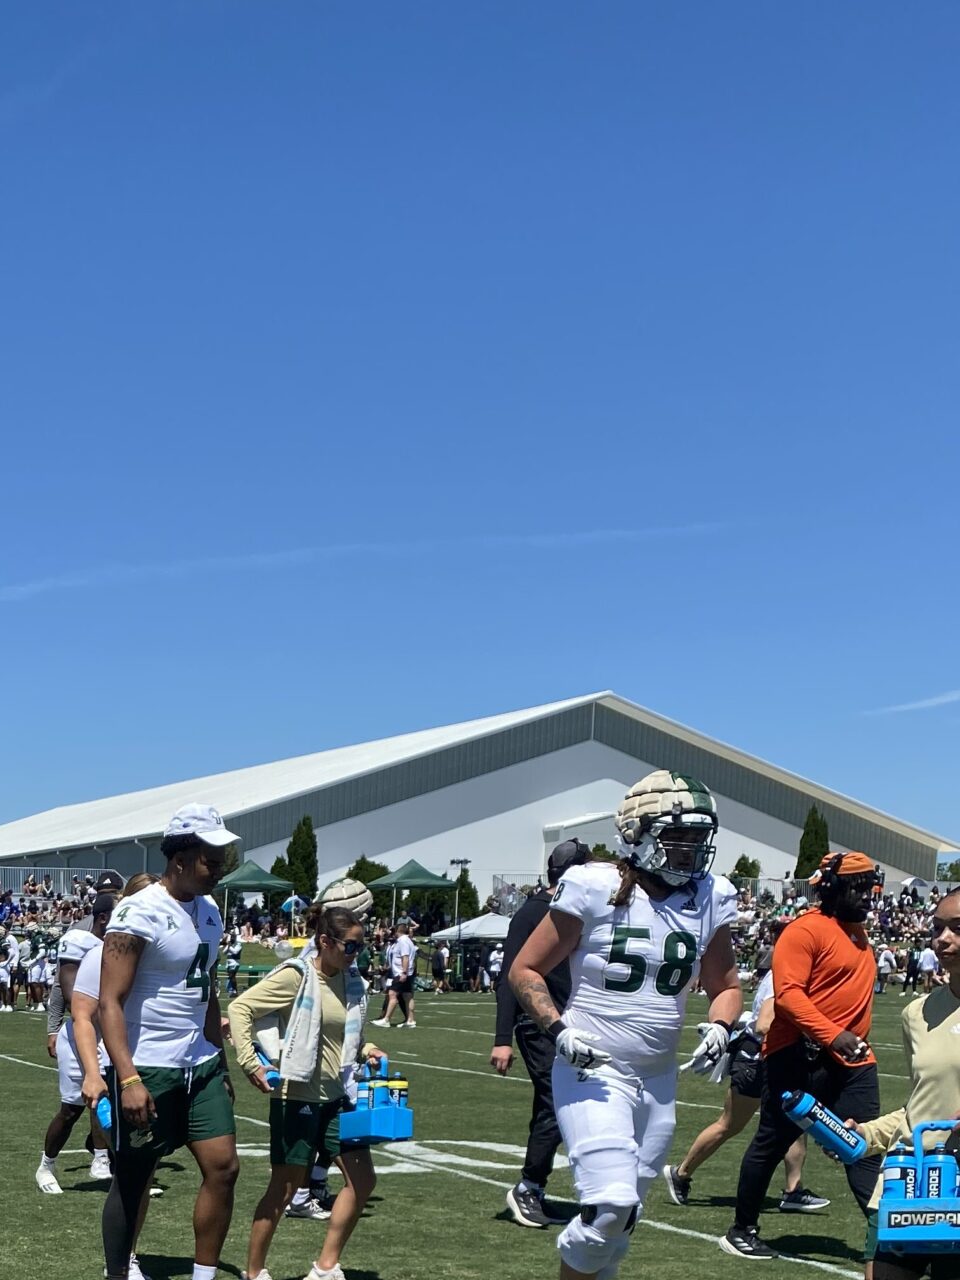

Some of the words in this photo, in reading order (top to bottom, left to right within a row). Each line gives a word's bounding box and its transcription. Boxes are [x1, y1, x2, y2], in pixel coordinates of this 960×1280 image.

[117, 906, 132, 922] 4
[185, 943, 210, 1004] 4
[603, 925, 698, 997] 58
[811, 1104, 859, 1147] POWERADE
